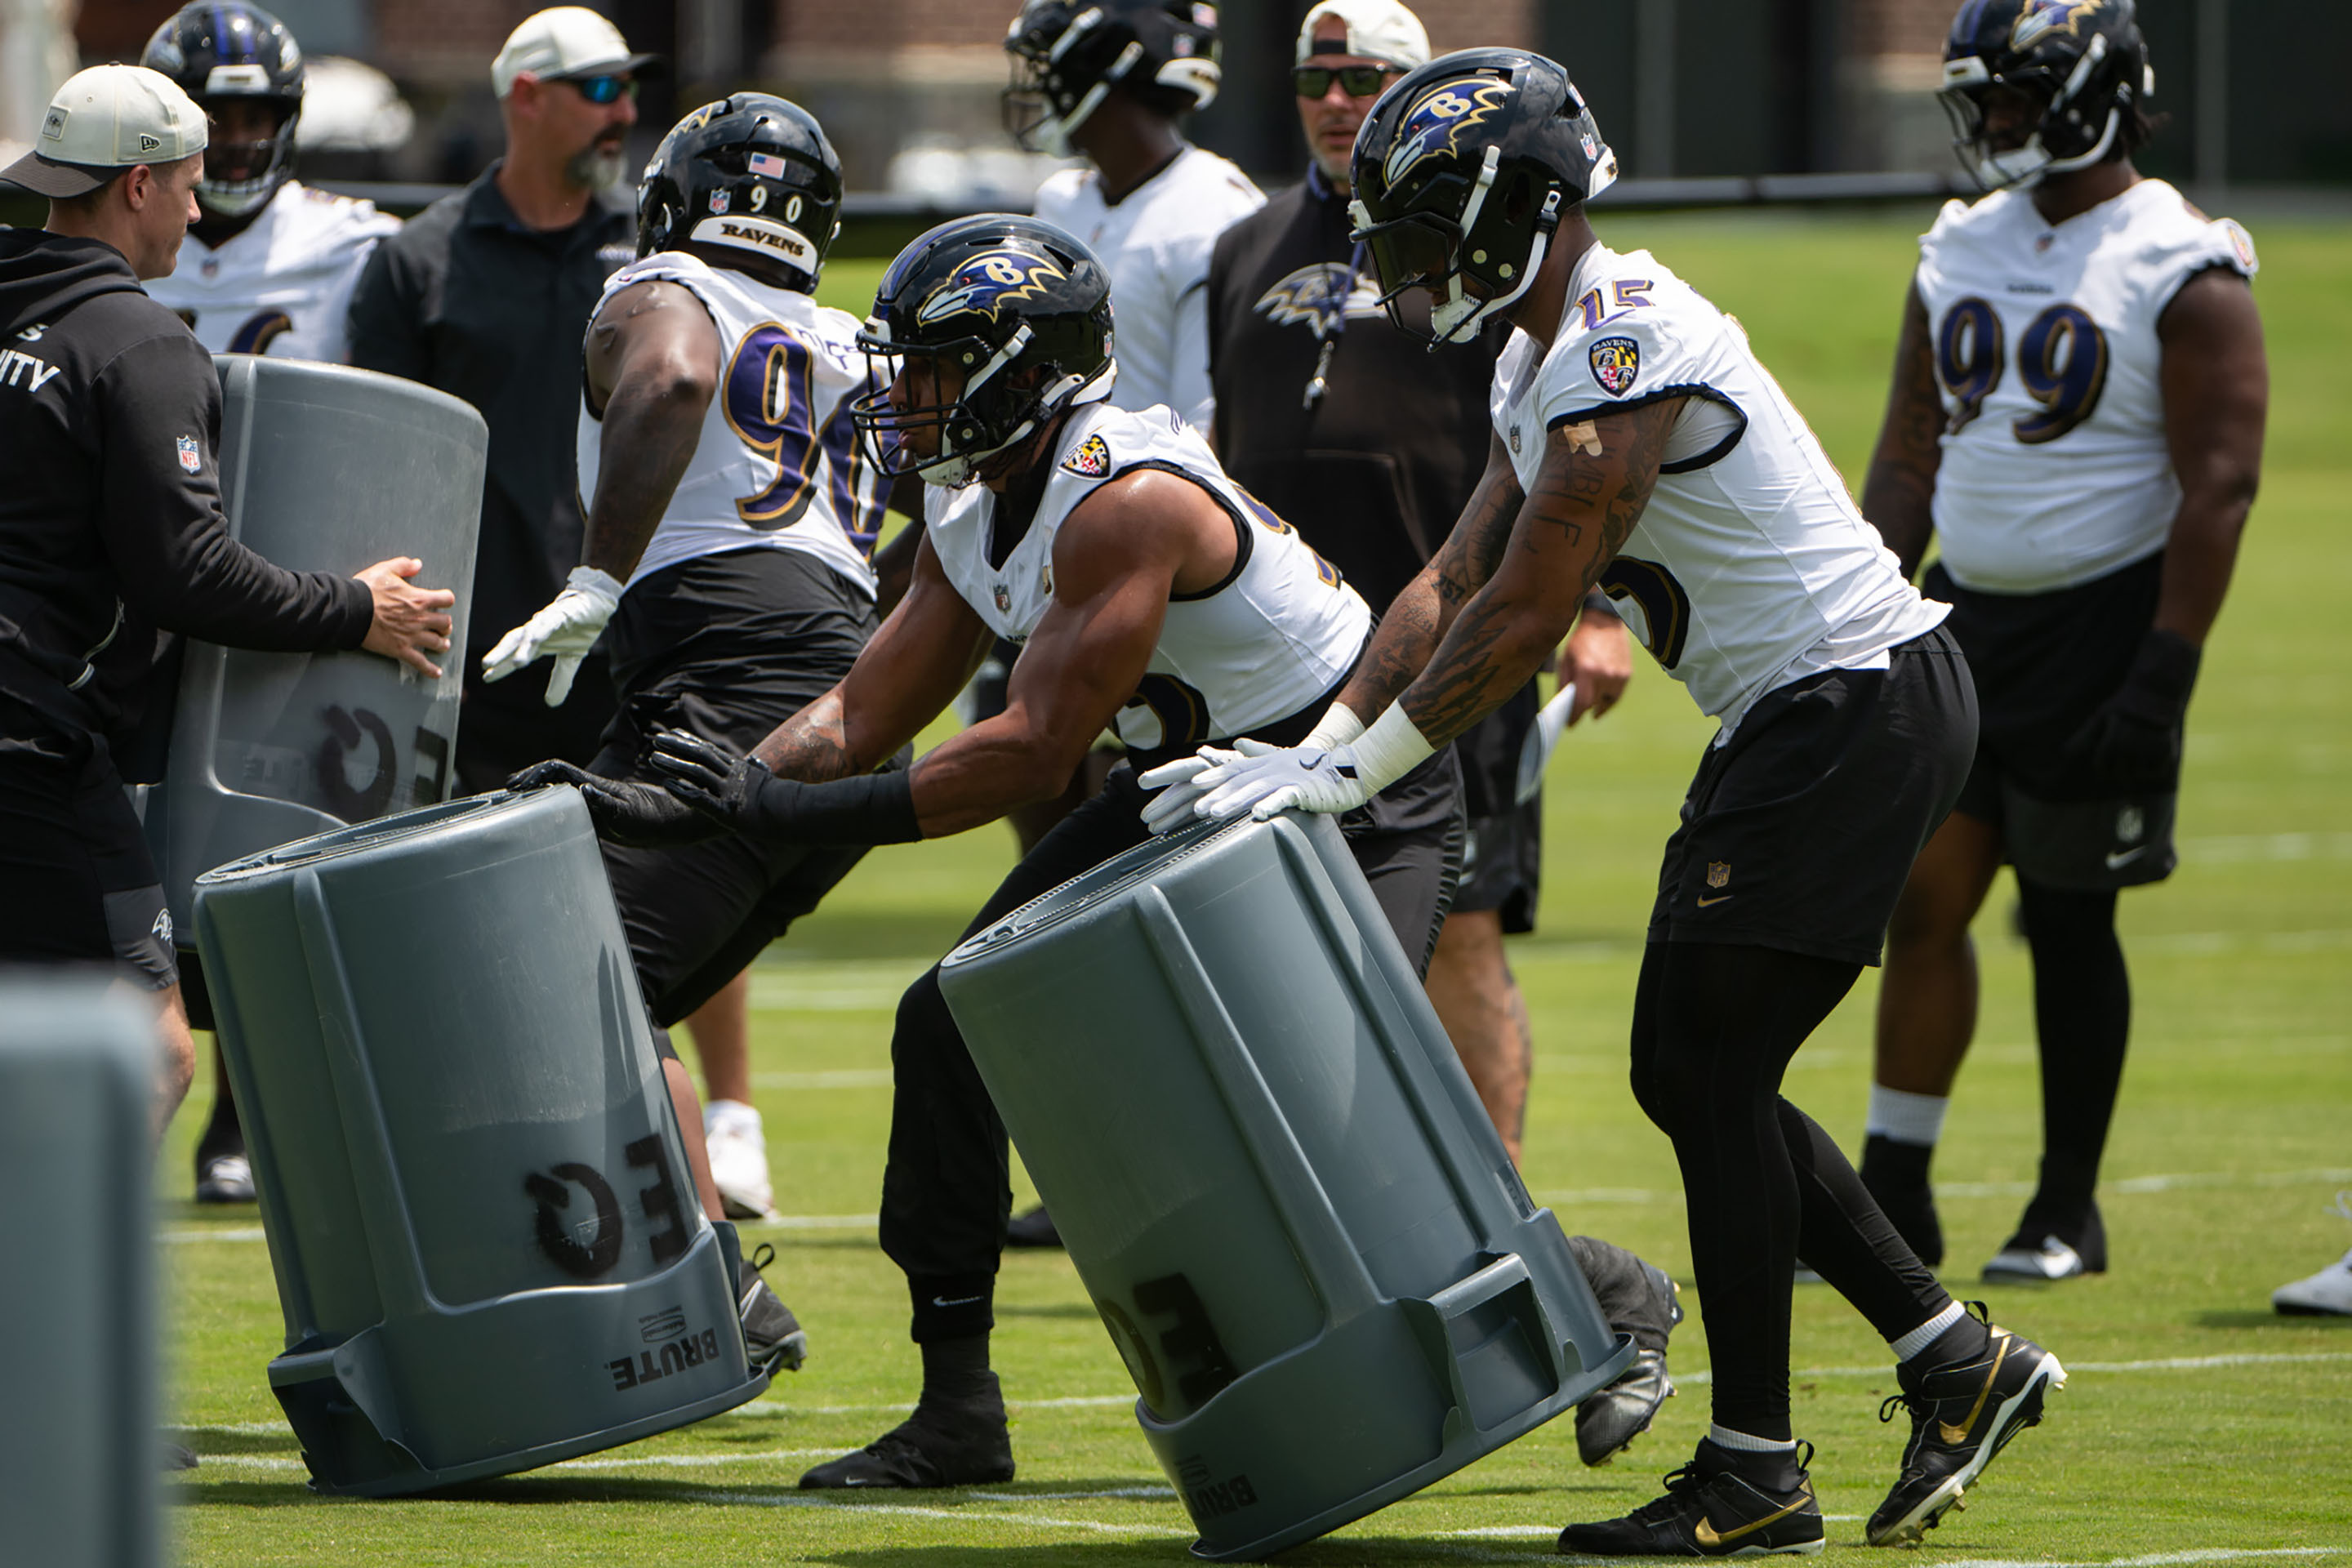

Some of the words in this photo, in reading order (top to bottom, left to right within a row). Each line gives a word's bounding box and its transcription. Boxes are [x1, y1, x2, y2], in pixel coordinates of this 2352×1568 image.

[720, 223, 805, 257] RAVENS
[1575, 279, 1655, 331] 15
[1592, 339, 1635, 351] RAVENS
[1939, 297, 2109, 444] 99
[609, 1327, 719, 1392] BRUTE
